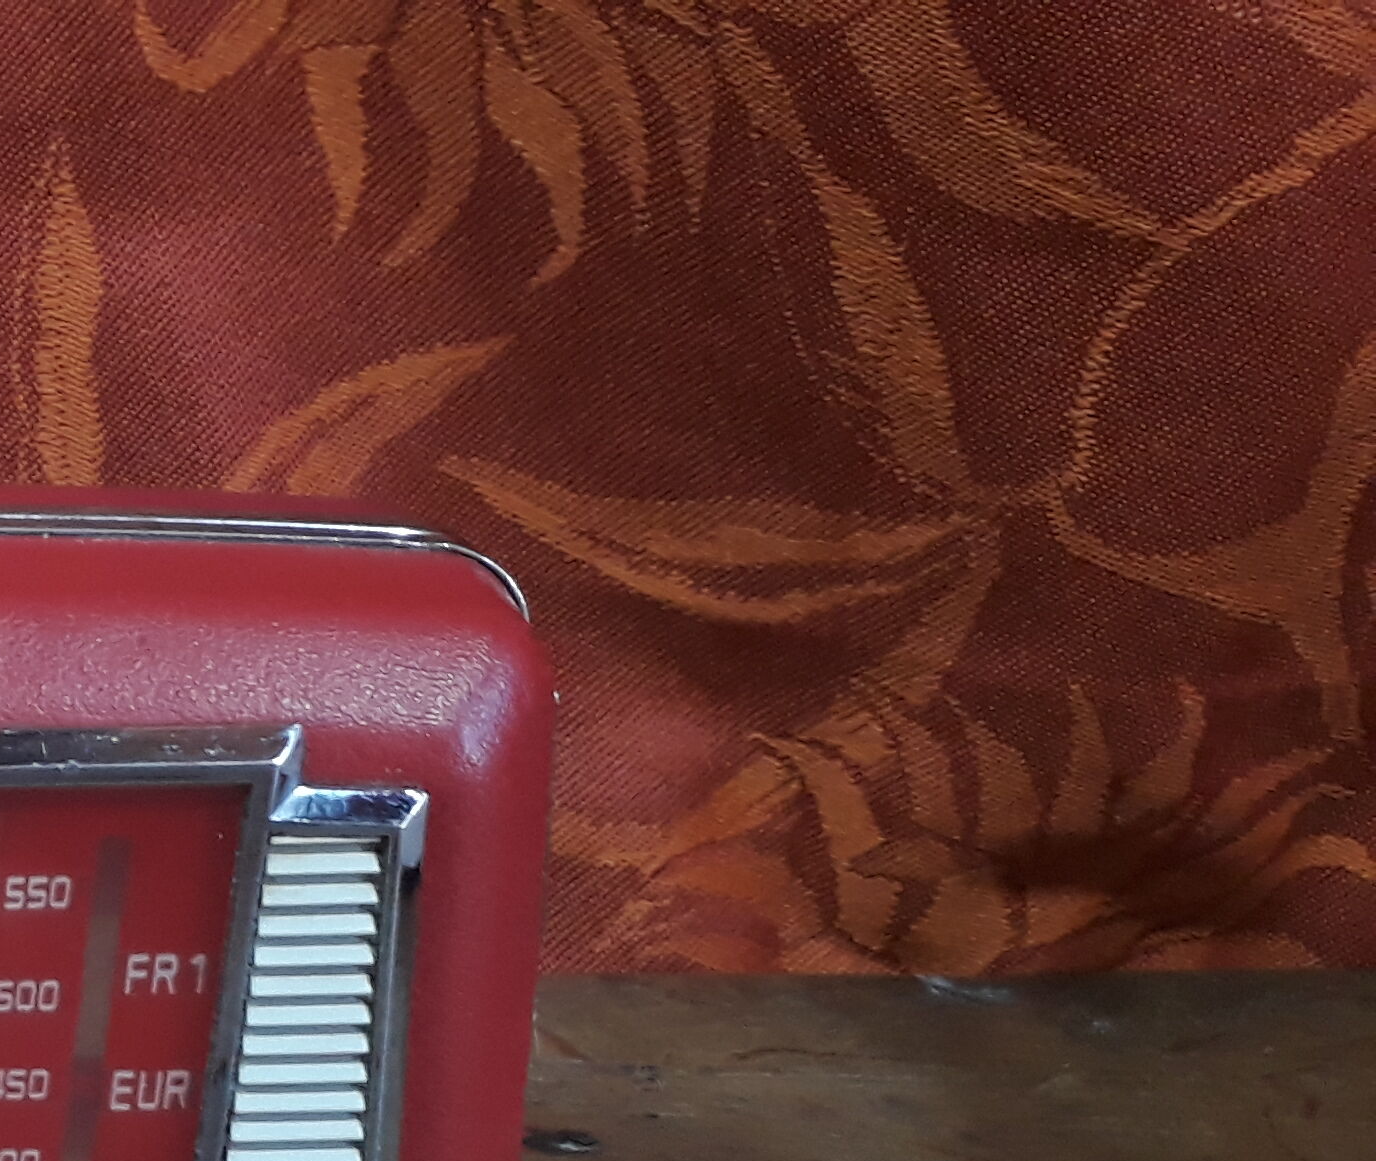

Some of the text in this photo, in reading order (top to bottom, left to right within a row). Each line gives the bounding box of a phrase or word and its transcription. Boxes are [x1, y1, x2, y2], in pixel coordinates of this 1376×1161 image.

[3, 875, 72, 910] 550
[124, 952, 208, 995] FR 1
[109, 1069, 192, 1112] EUR
